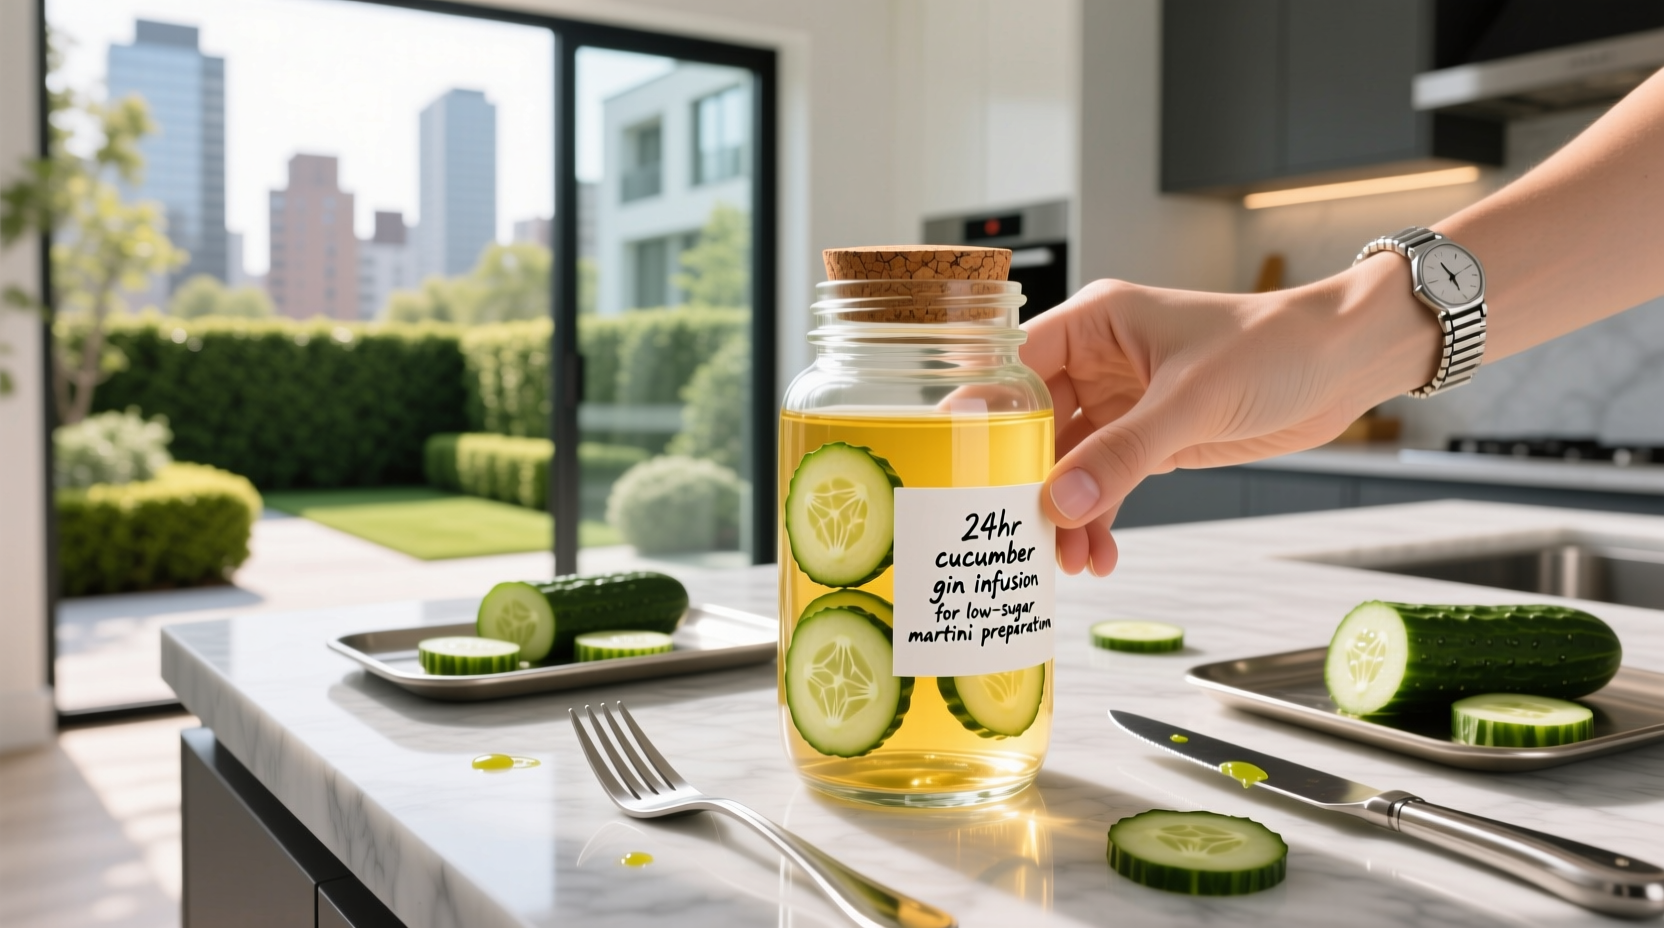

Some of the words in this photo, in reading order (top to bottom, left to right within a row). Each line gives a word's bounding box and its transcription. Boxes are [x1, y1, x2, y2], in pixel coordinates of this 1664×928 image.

[961, 508, 1022, 541] 24hr
[935, 540, 1035, 568] cucumber
[929, 576, 965, 604] gin
[975, 570, 1038, 599] infusion
[935, 603, 960, 623] for
[966, 601, 1035, 622] low-sugar
[908, 624, 973, 643] martini
